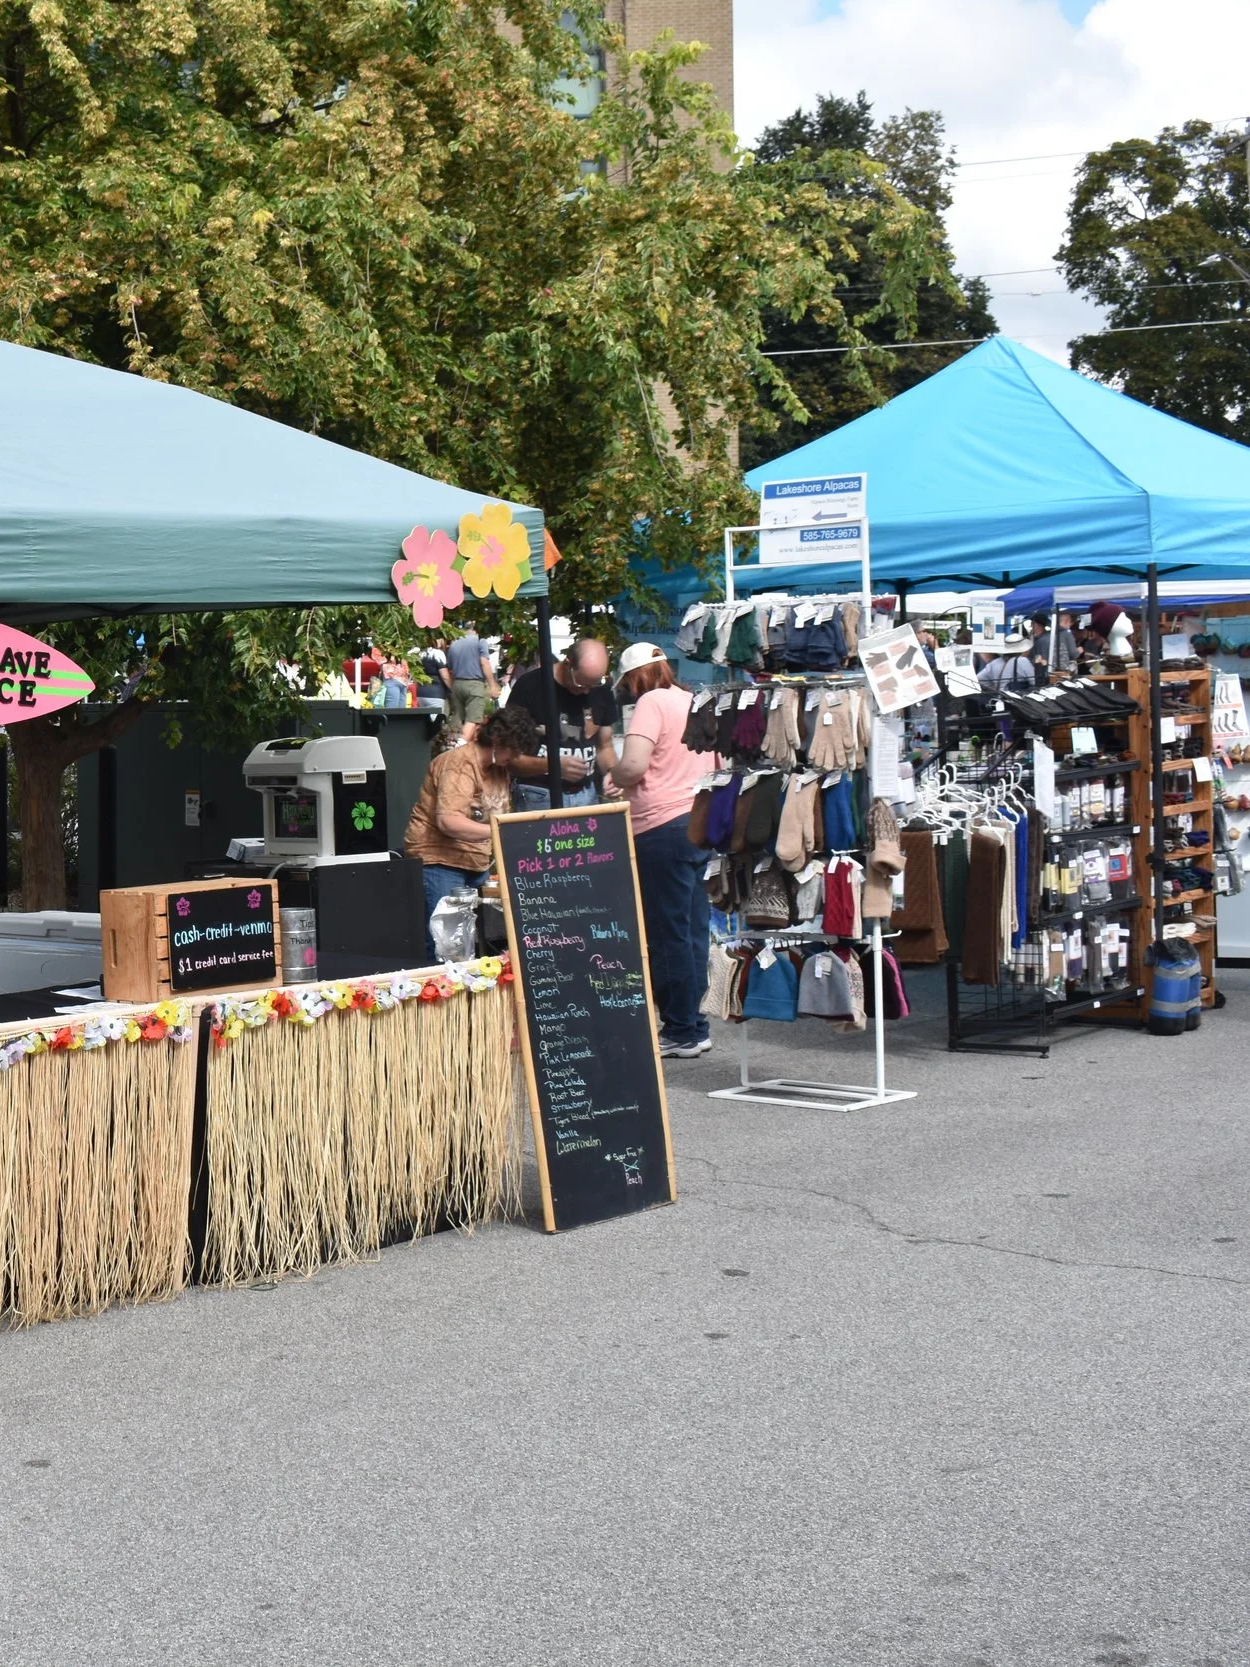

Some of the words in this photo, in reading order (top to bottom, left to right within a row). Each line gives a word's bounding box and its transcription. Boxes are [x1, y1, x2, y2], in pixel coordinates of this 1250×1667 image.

[776, 483, 822, 496] Lakeshore
[823, 479, 860, 492] Alpacas
[803, 528, 859, 541] 585-765-9679
[549, 820, 580, 836] Aloha
[554, 839, 574, 850] one
[576, 834, 596, 848] size
[518, 857, 543, 873] Pick
[546, 857, 555, 870] 1
[559, 857, 572, 868] or
[575, 853, 584, 866] 2
[513, 876, 543, 891] Blue
[543, 872, 593, 888] Raspberry
[517, 892, 557, 906] Banana
[520, 908, 540, 921] Blue
[522, 923, 560, 935] Coconut
[523, 931, 543, 948] Red
[541, 932, 586, 952] Raspberry
[178, 957, 193, 975] $1
[195, 955, 217, 970] credit
[219, 951, 237, 965] card
[238, 950, 261, 962] service
[262, 949, 274, 960] fee
[526, 949, 555, 962] Cherry
[590, 953, 626, 970] Peach
[527, 962, 559, 973] Grape
[530, 975, 558, 988] Gummy
[532, 988, 561, 999] Lemon
[534, 1001, 557, 1010] Lime
[567, 1003, 590, 1017] Punch
[539, 1023, 566, 1037] Mango
[542, 1052, 561, 1065] Pink
[548, 1091, 568, 1102] Root
[551, 1099, 592, 1113] Strawberry
[570, 1112, 590, 1120] Blood
[556, 1129, 579, 1139] Vanilla
[556, 1135, 602, 1155] Watermelon
[625, 1172, 643, 1187] Peach
